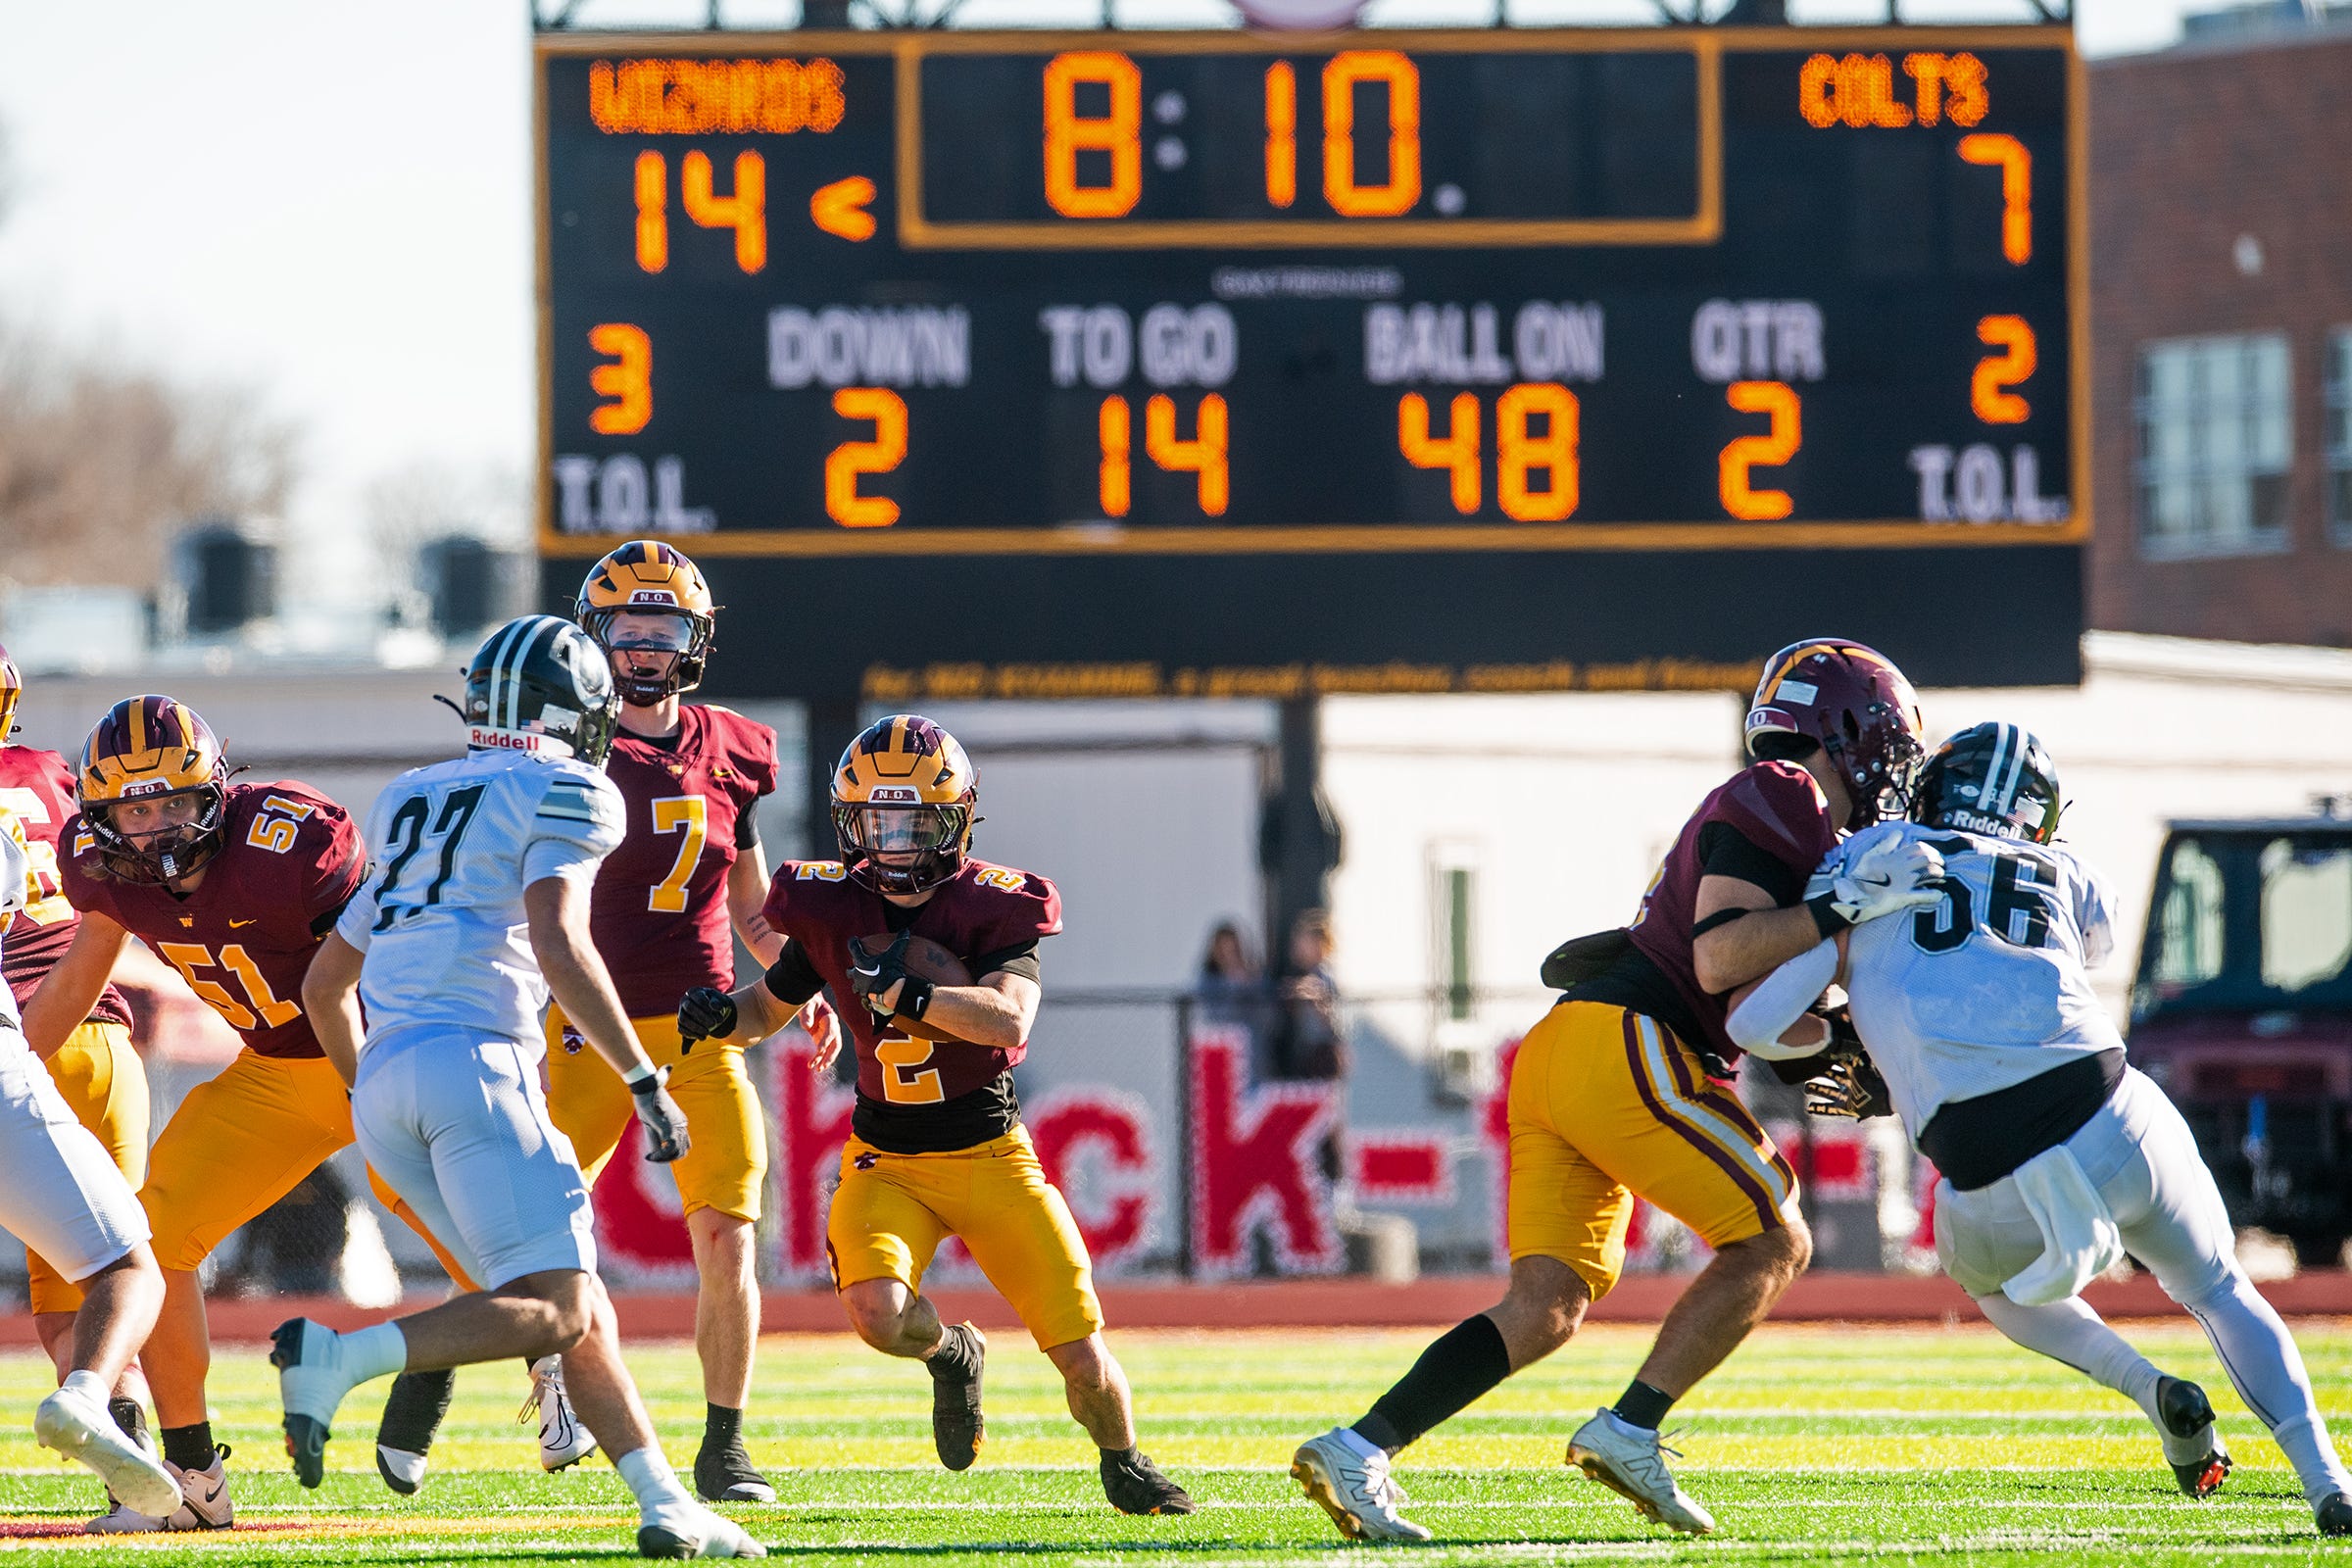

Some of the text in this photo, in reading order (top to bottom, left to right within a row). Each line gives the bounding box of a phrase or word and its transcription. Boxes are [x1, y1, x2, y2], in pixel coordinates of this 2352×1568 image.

[1799, 52, 1989, 128] COLTS
[635, 149, 766, 275] 14
[1957, 132, 2032, 267] 7
[588, 322, 654, 436] 3
[767, 305, 971, 389] DOWN
[1041, 303, 1238, 388] TO GO
[1363, 302, 1605, 385] BALL ON
[1690, 299, 1826, 383] QTR
[1970, 314, 2037, 424] 2
[824, 387, 908, 529] 2
[1099, 394, 1231, 517] 14
[1398, 383, 1580, 522] 48
[1718, 381, 1802, 521] 2
[470, 728, 540, 752] Riddell
[245, 794, 315, 856] 51
[369, 782, 491, 932] 27
[647, 795, 708, 913] 7
[1951, 808, 2022, 841] Riddell
[795, 862, 848, 883] 2
[973, 867, 1029, 893] 2
[158, 941, 304, 1031] 51
[874, 1013, 947, 1105] 2
